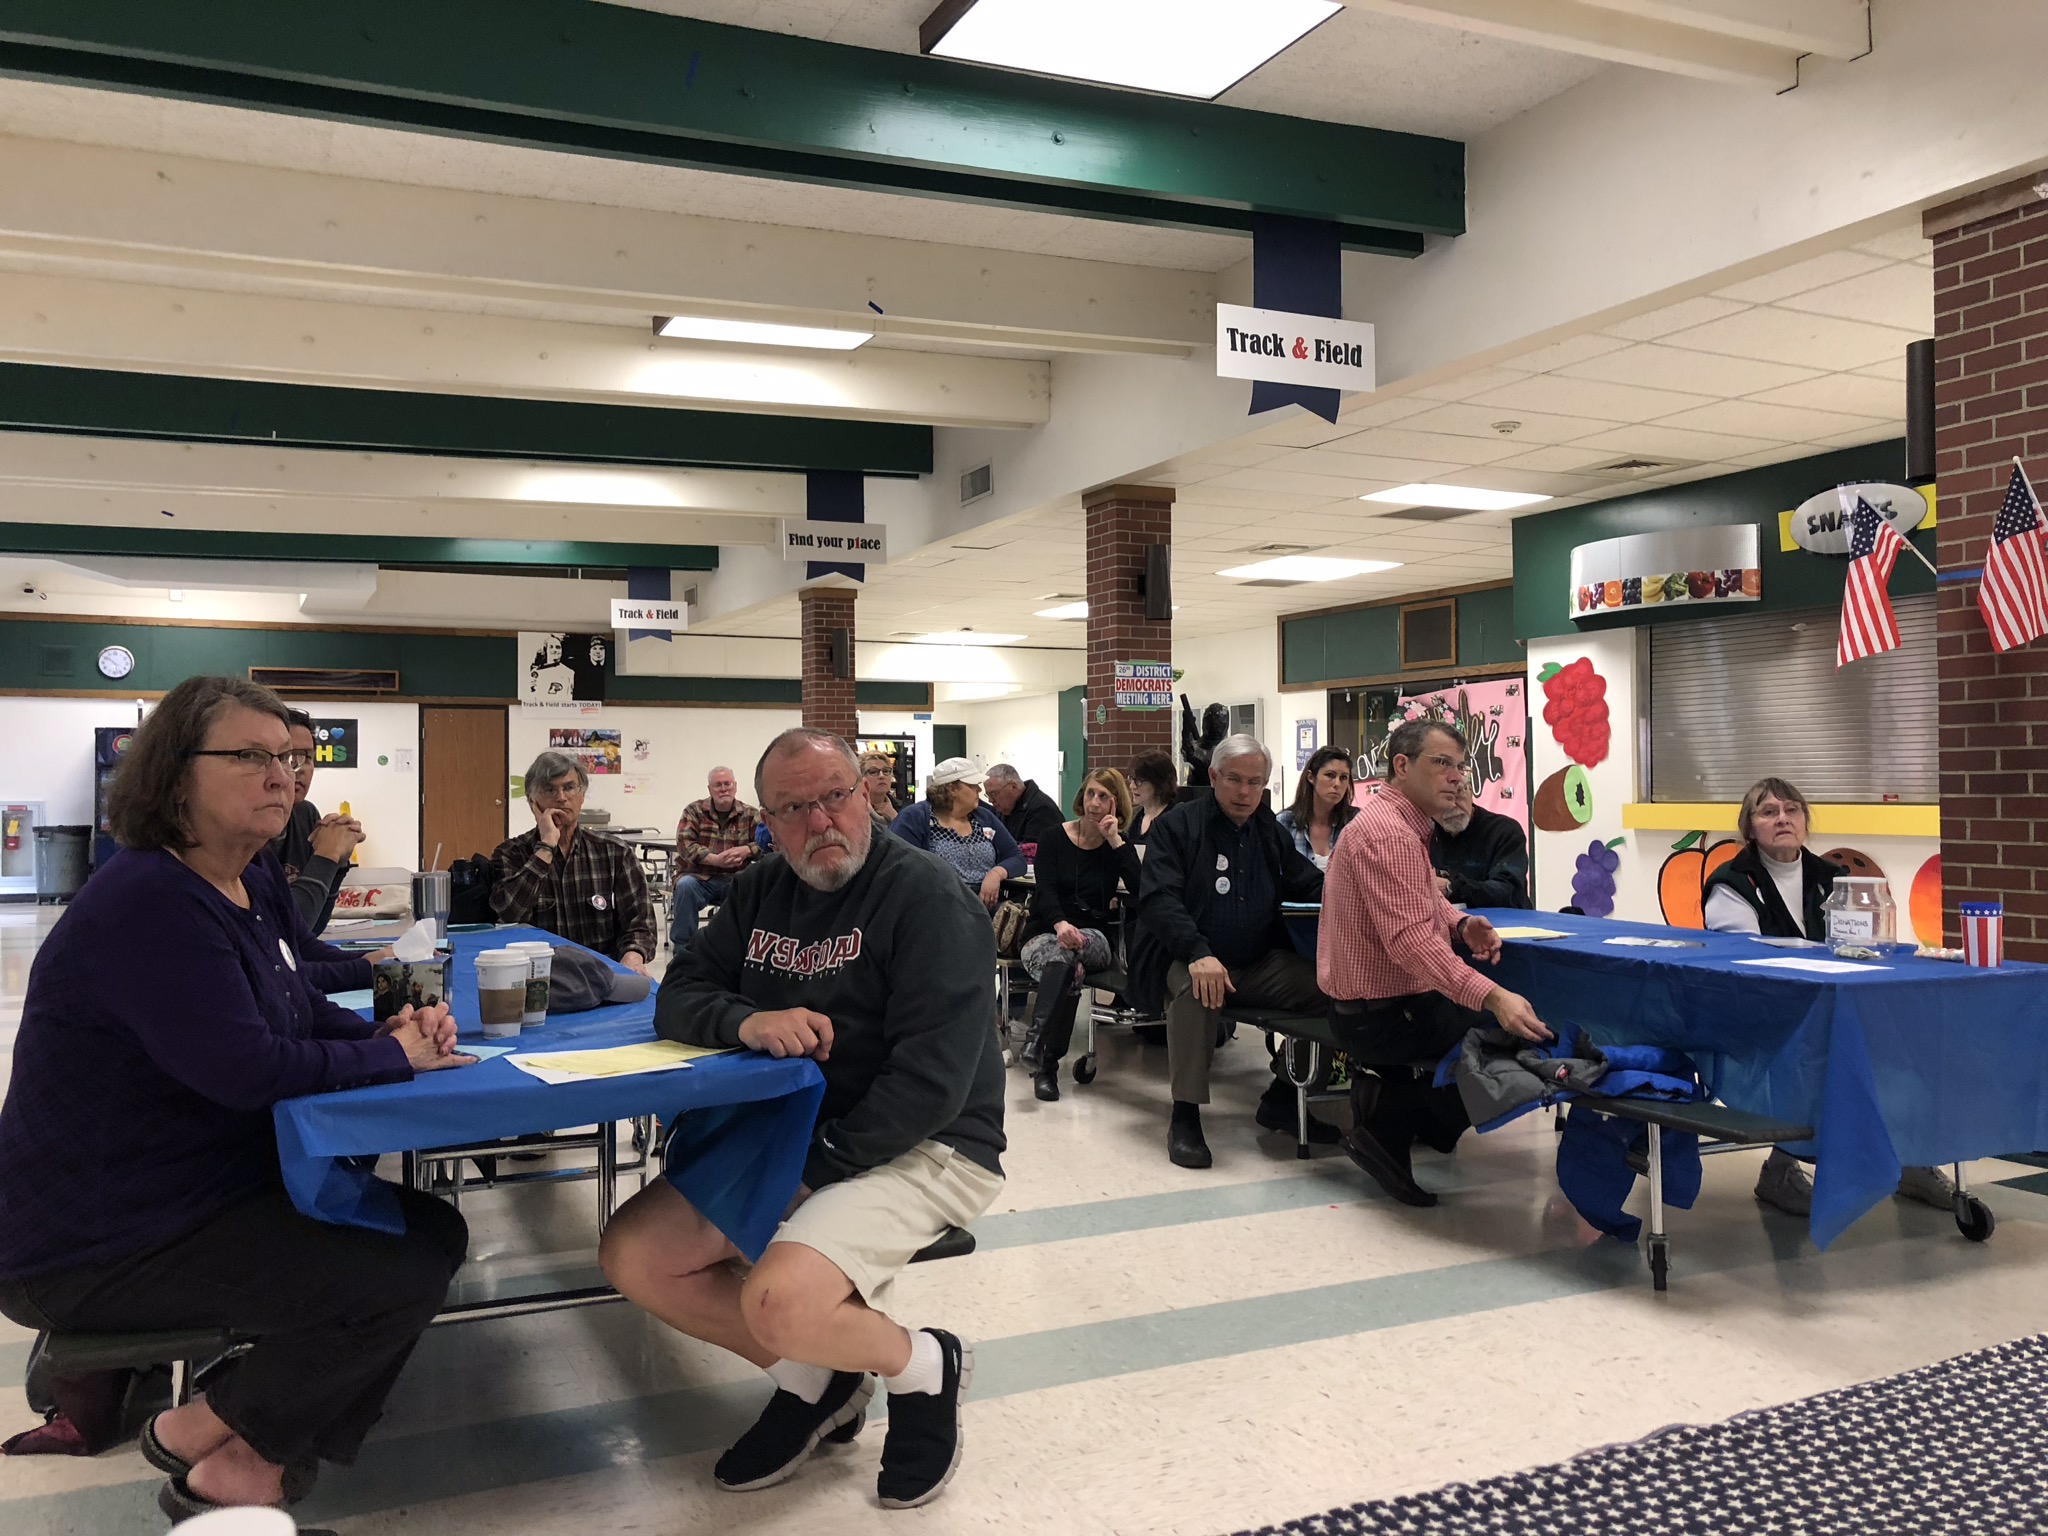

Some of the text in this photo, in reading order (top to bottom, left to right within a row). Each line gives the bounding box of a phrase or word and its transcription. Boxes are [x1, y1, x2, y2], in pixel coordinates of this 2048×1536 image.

[1226, 327, 1363, 368] Track & Field
[788, 533, 814, 547] Find
[816, 536, 844, 549] your
[618, 608, 679, 620] Track & Field
[1135, 665, 1171, 677] DISTRICT
[1116, 679, 1172, 692] DEMOCRATS
[1116, 692, 1171, 705] MEETING HERE
